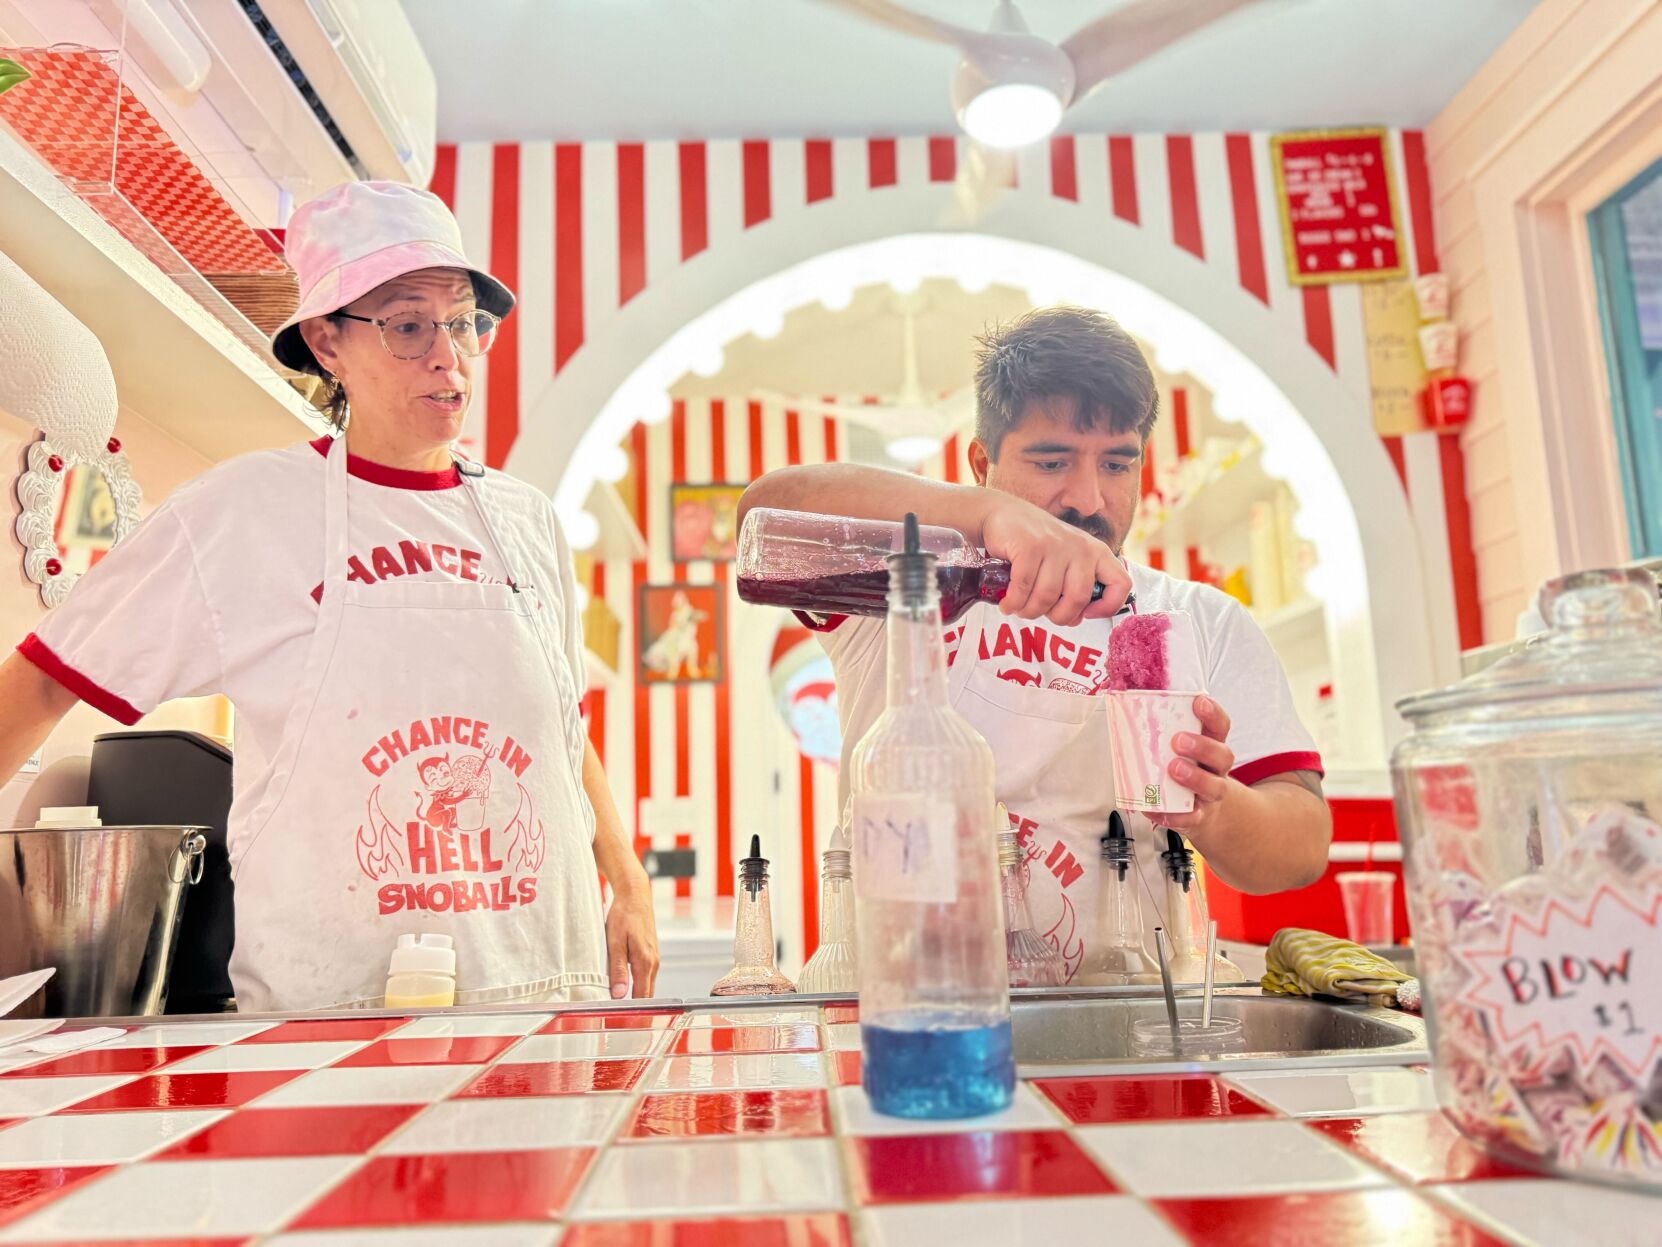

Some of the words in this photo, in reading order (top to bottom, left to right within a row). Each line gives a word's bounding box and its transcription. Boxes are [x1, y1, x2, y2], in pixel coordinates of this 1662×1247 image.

[361, 716, 489, 778] CHANCE
[499, 736, 533, 778] IN
[406, 821, 503, 875] HELL
[1044, 840, 1084, 889] IN
[378, 876, 538, 916] SNOBALLS
[1501, 948, 1633, 1005] BLOW
